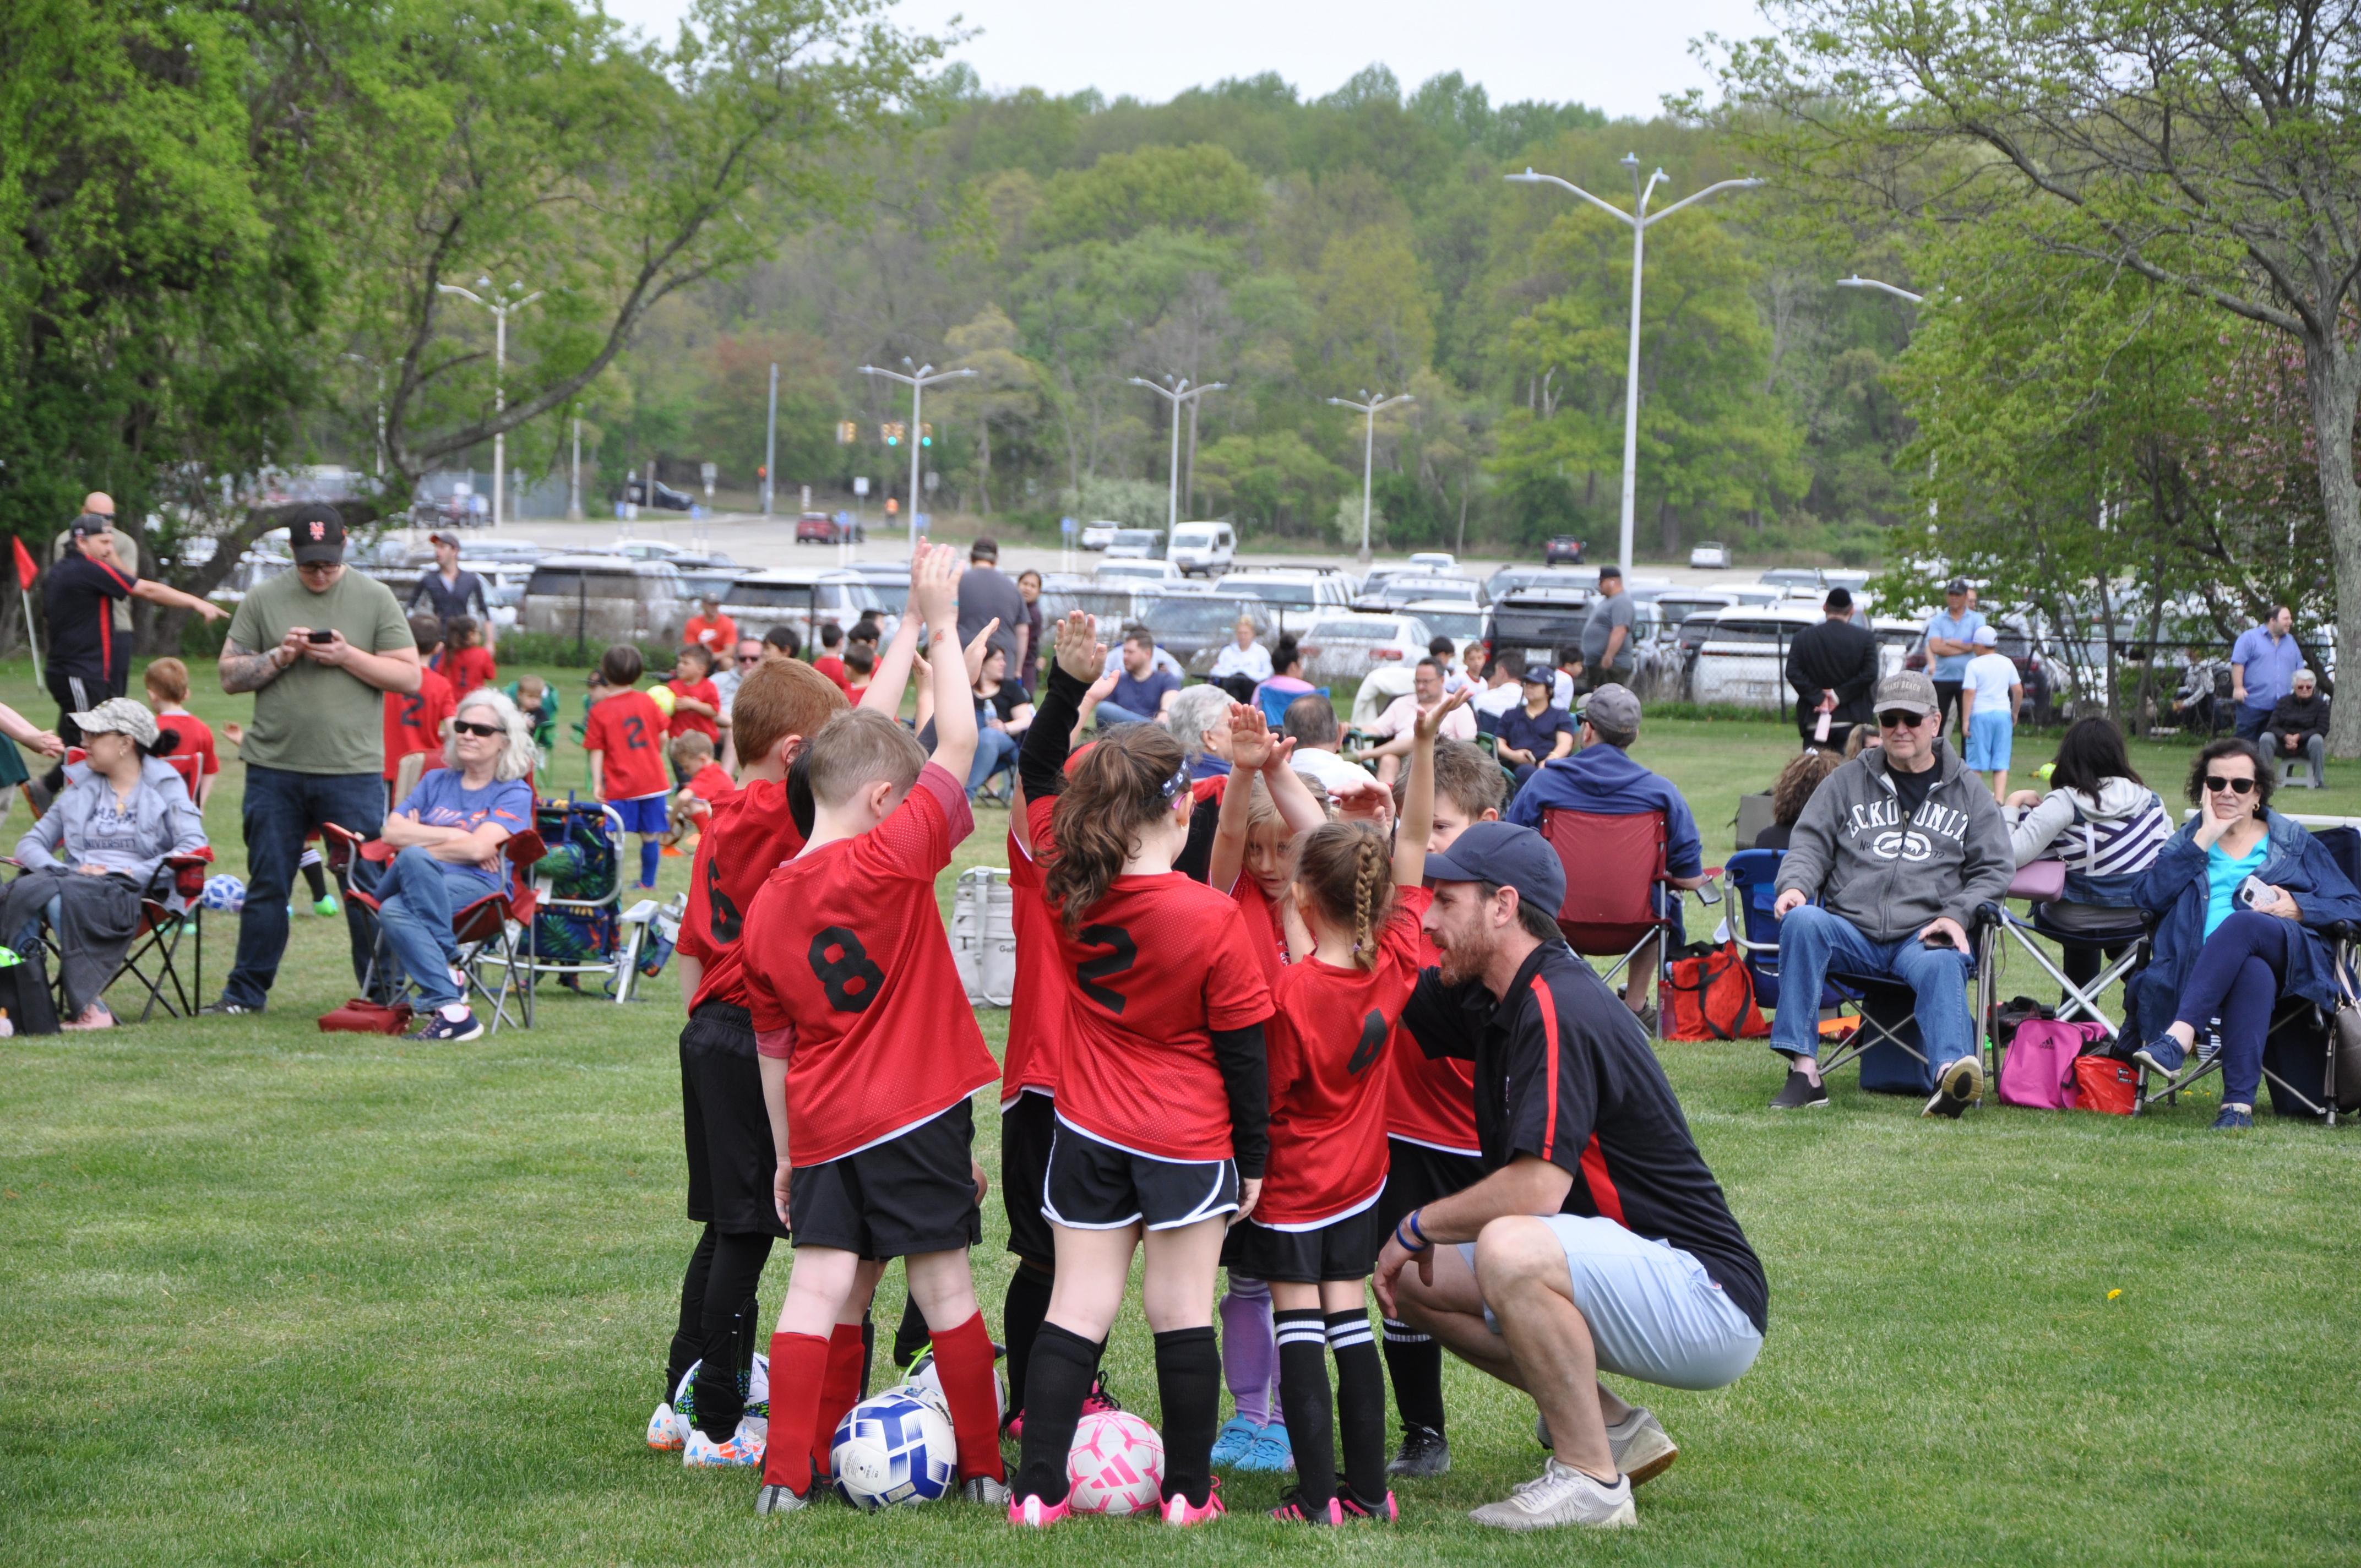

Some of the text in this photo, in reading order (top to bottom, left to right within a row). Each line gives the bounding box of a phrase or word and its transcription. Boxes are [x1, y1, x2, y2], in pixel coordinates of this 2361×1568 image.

[459, 666, 467, 687] 1
[1901, 680, 1921, 692] BEACH
[401, 692, 424, 727] 2
[623, 716, 647, 749] 2
[1933, 850, 1945, 859] 72
[708, 856, 743, 944] 6
[808, 925, 886, 1013] 8
[1076, 923, 1139, 1016] 2
[1347, 1007, 1388, 1082] 4
